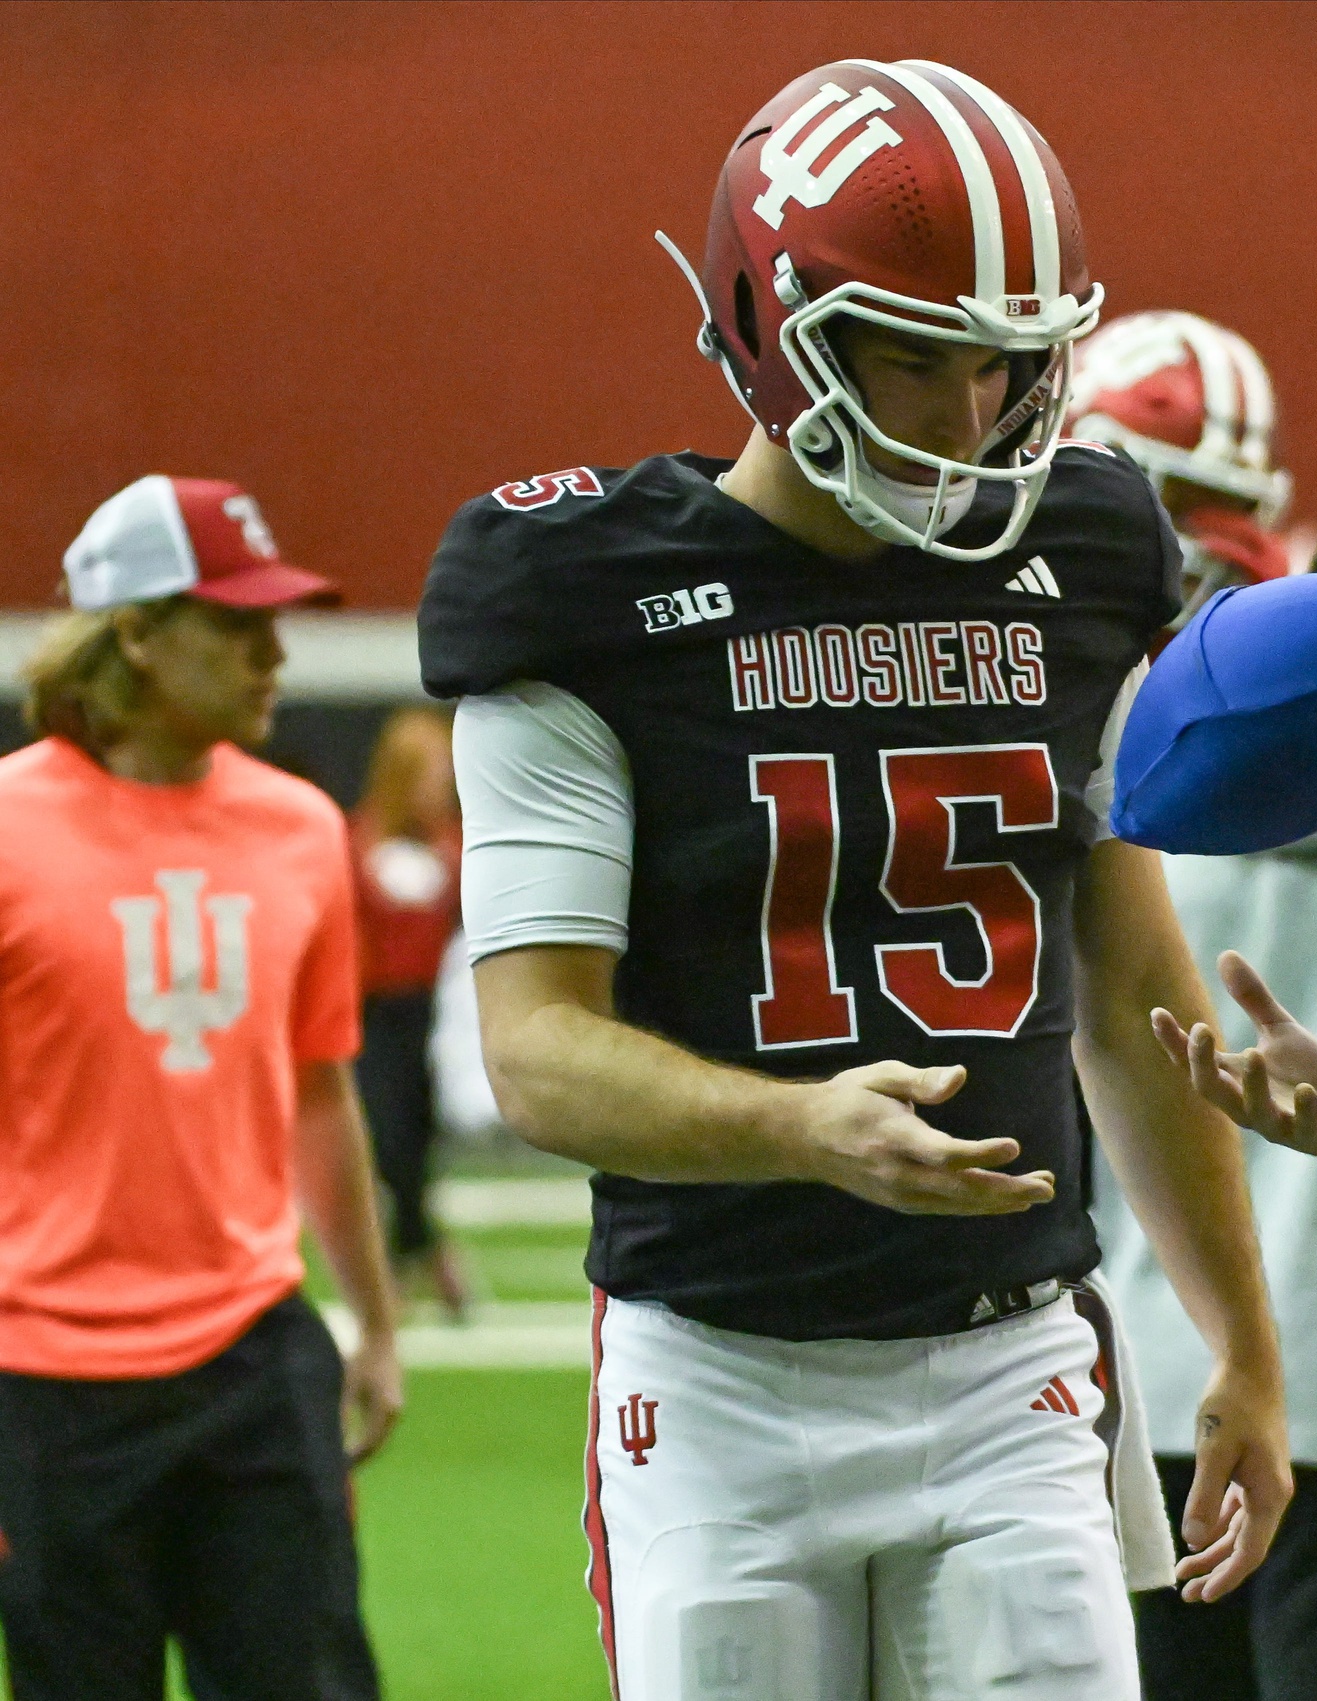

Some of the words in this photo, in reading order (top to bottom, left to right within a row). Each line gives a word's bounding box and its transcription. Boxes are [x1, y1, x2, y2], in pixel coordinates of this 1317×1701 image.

[996, 384, 1048, 436] INDIANA
[728, 620, 1047, 711] HOOSIERS
[748, 743, 1060, 1051] 15
